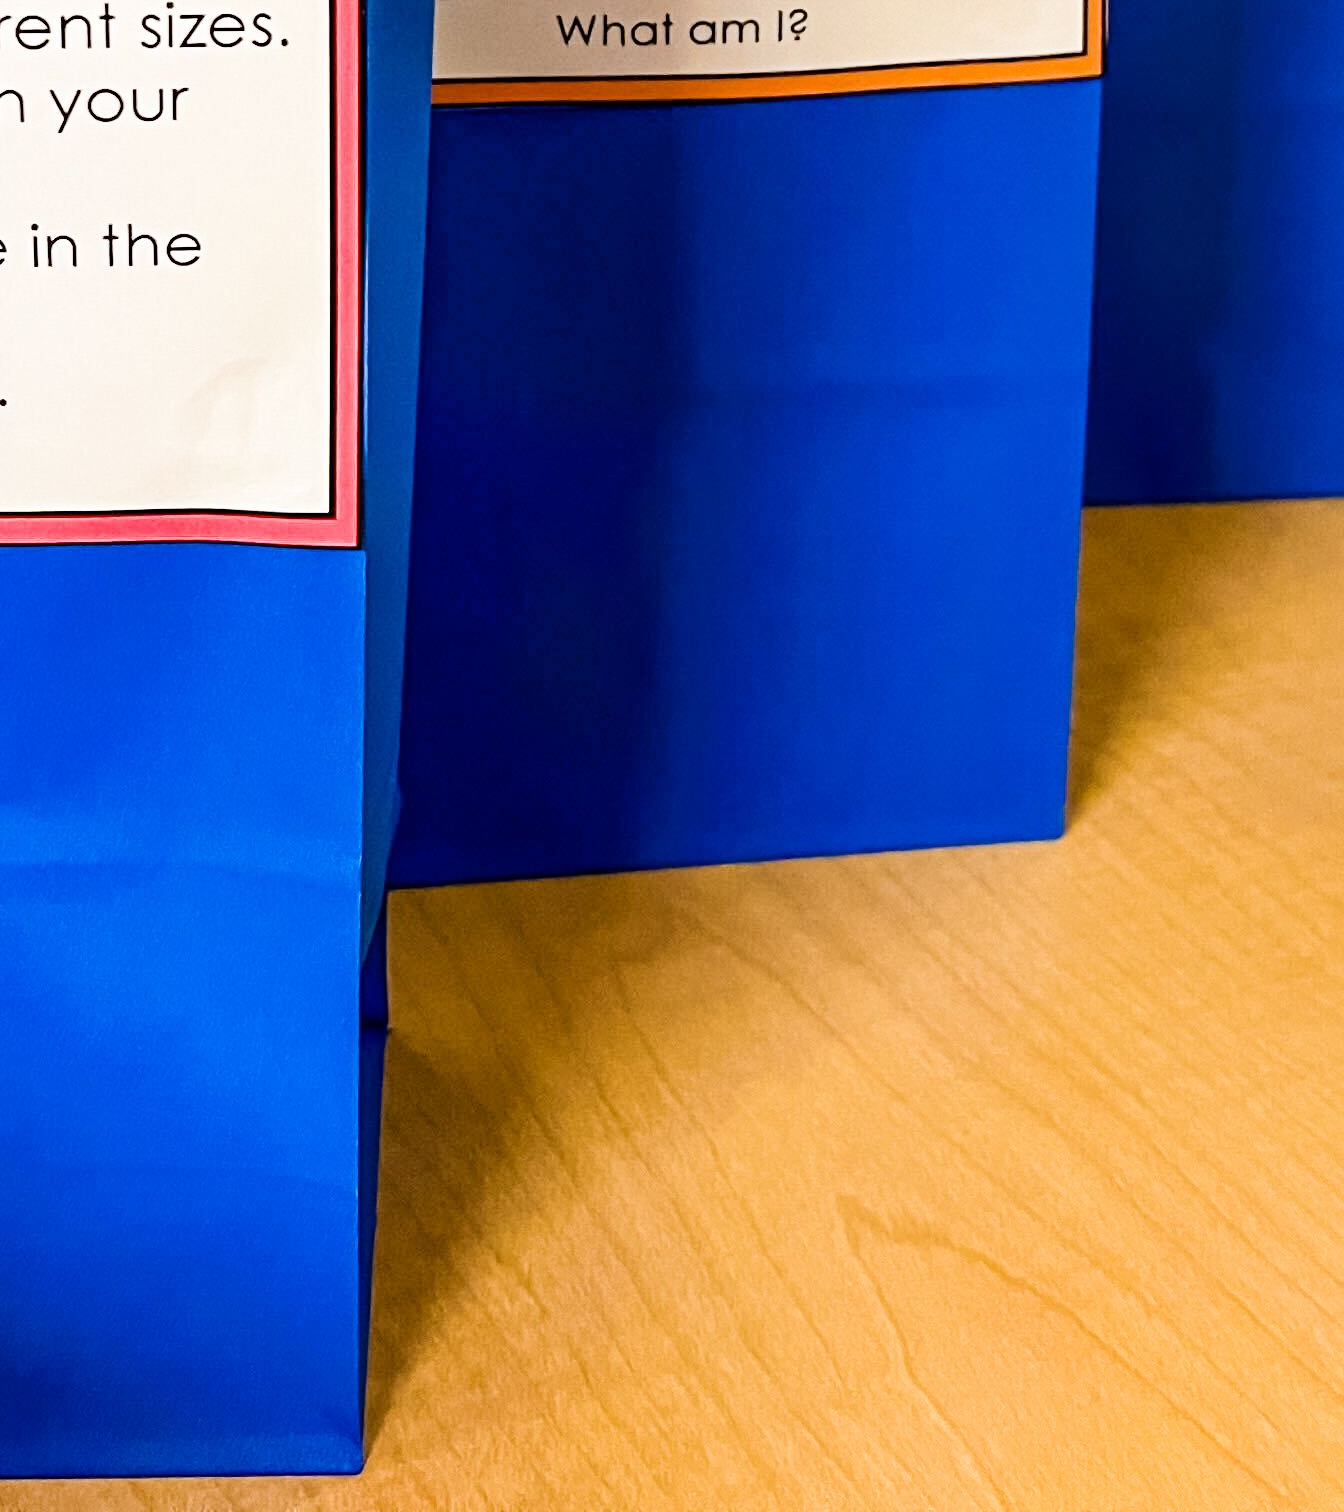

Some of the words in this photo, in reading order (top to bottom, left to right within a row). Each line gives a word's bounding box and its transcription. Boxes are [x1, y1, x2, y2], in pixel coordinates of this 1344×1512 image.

[140, 1, 290, 50] sizes.
[555, 12, 674, 47] What
[689, 19, 760, 46] am
[777, 8, 809, 43] I?
[48, 87, 190, 134] your
[30, 222, 78, 268] in
[101, 223, 202, 268] the
